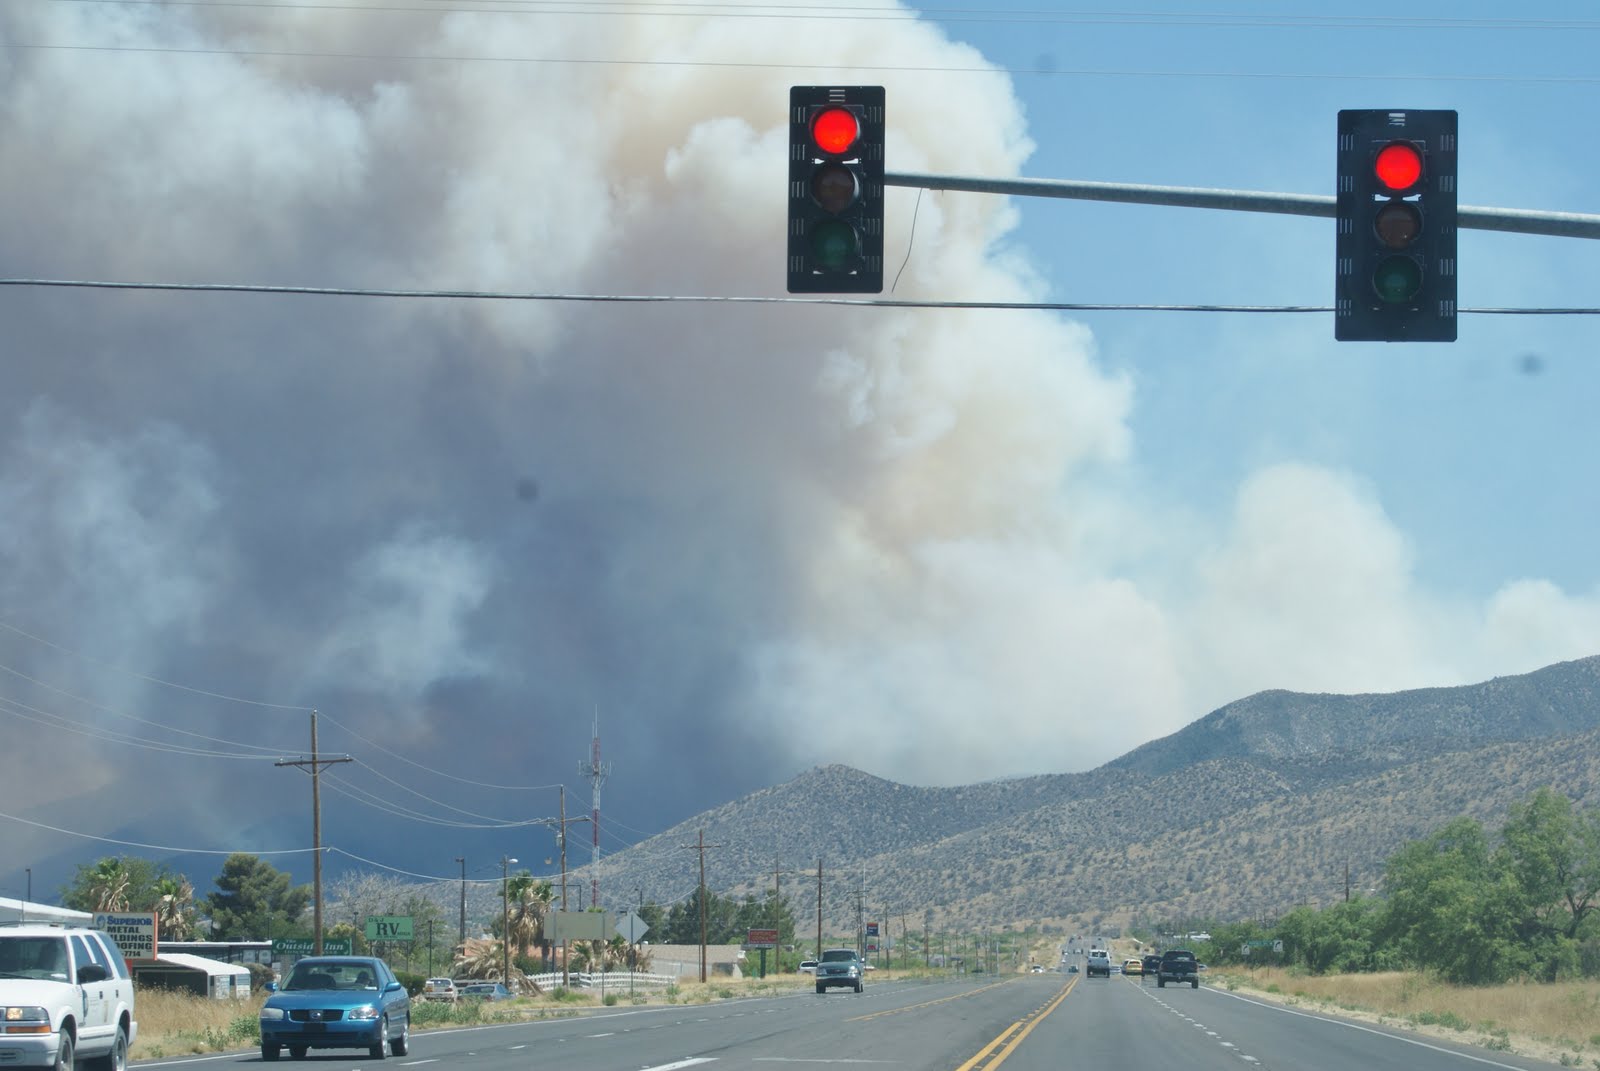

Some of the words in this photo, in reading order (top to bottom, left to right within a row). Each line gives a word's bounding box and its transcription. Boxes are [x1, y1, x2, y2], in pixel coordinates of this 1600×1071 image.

[107, 915, 152, 926] SUPERIOR
[376, 922, 400, 936] RV
[276, 942, 315, 950] Outsid
[324, 942, 344, 950] Inn
